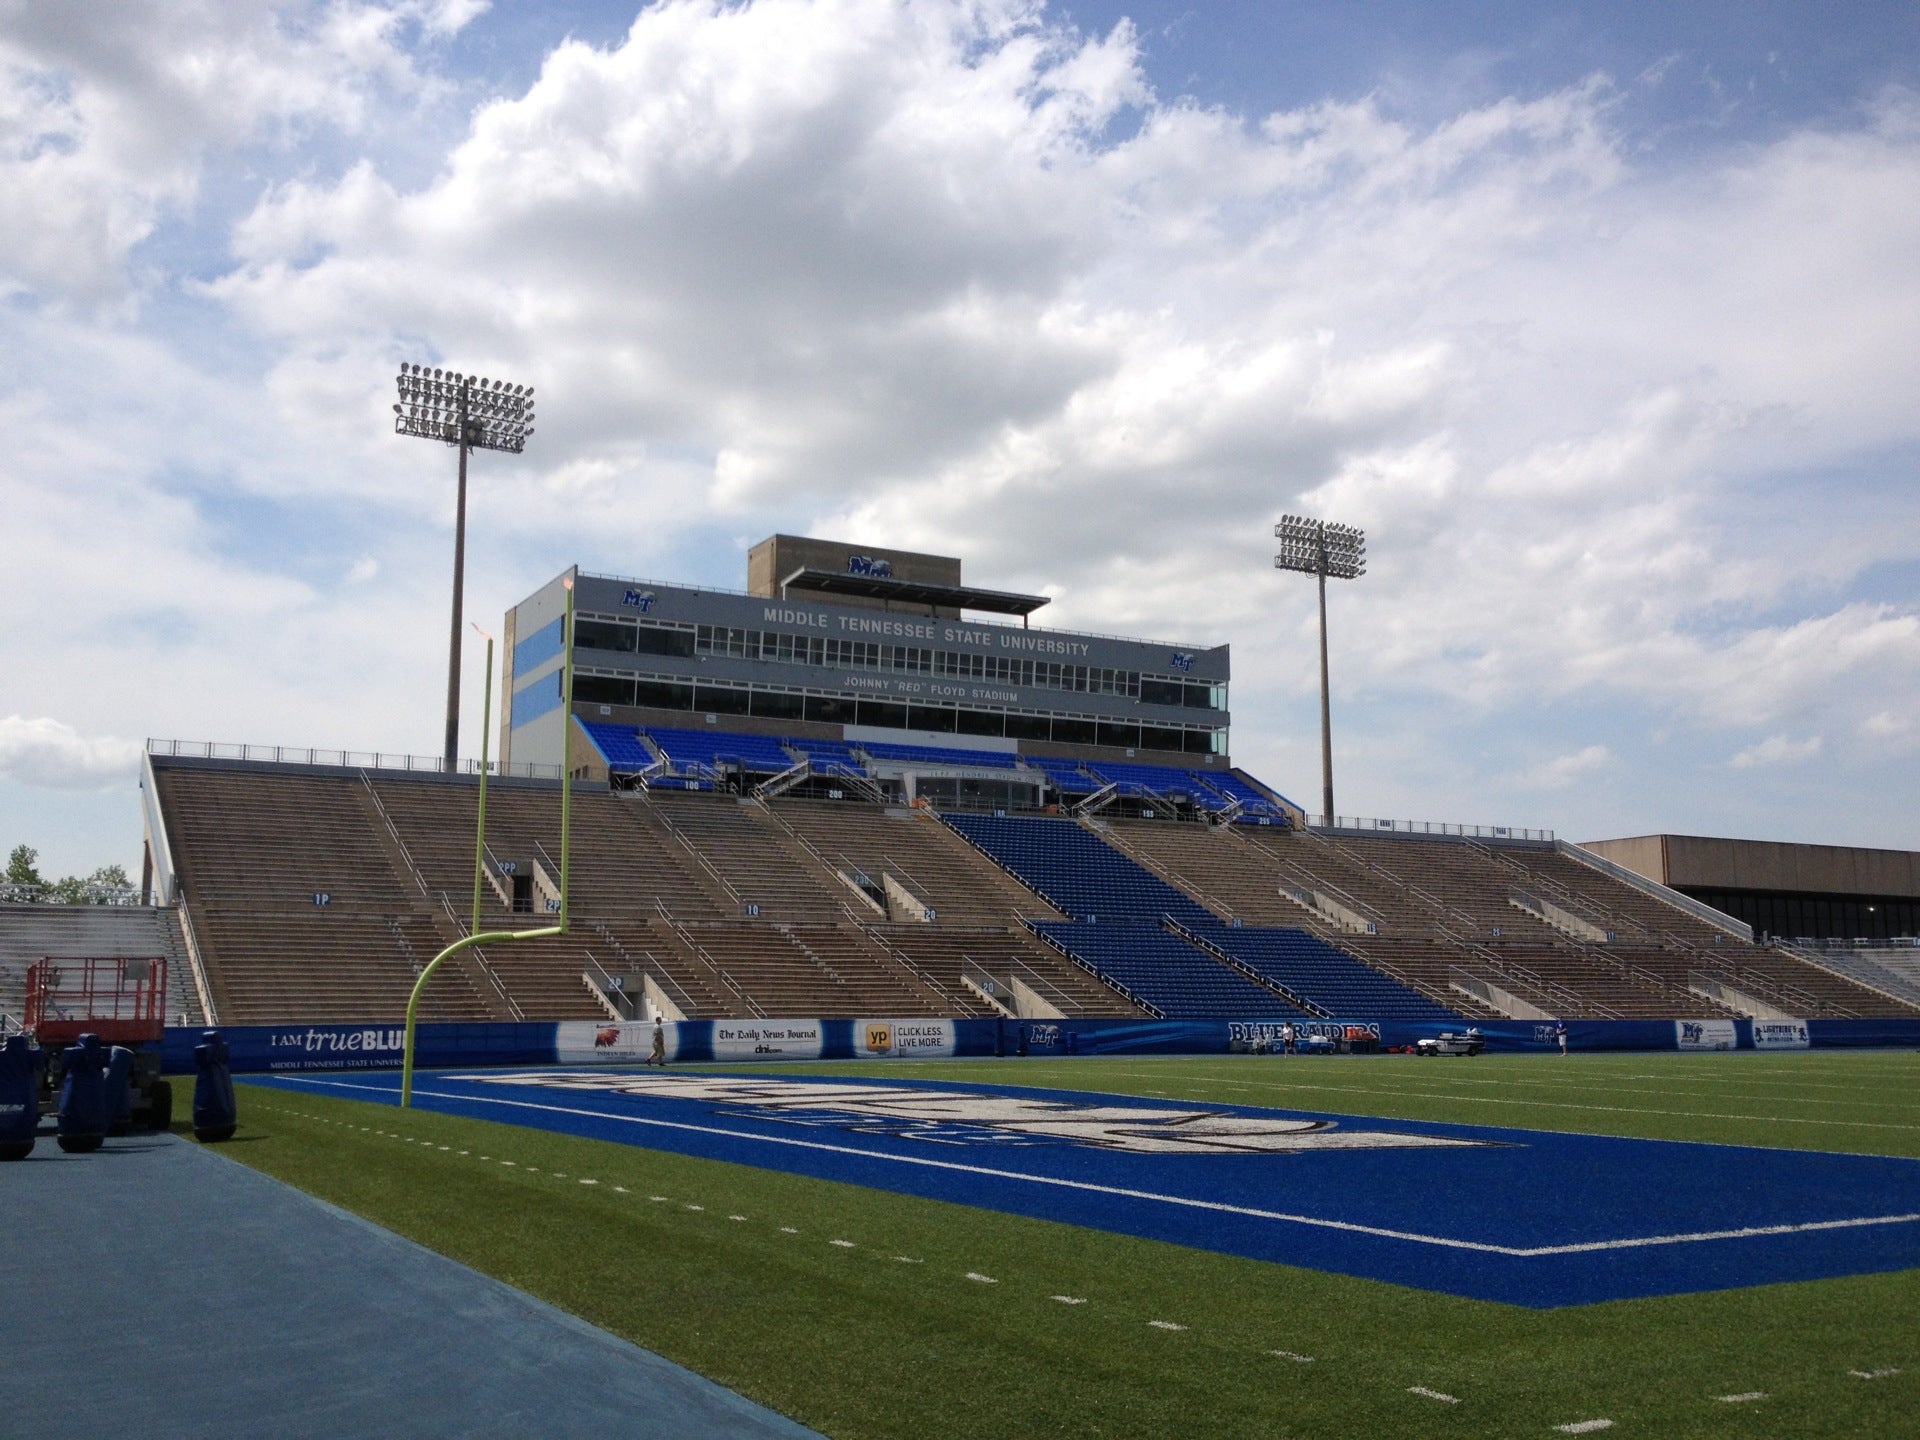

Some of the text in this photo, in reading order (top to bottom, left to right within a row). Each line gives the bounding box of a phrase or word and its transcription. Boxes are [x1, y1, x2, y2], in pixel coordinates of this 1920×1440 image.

[764, 607, 1089, 656] MIDDLE TENNESSEE STATE UNIVERSITY
[844, 677, 889, 689] JOHNNY
[931, 685, 966, 697] FLOYD
[972, 689, 1018, 702] STADIUM
[315, 893, 329, 905] 1P
[547, 900, 560, 911] 2P
[719, 1029, 817, 1040] The Daily News Journal
[870, 1030, 888, 1044] yp
[898, 1027, 921, 1037] CLICK
[1228, 1022, 1285, 1042] BLUE
[271, 1035, 278, 1046] I
[280, 1034, 302, 1046] AM
[898, 1038, 916, 1047] LIVE
